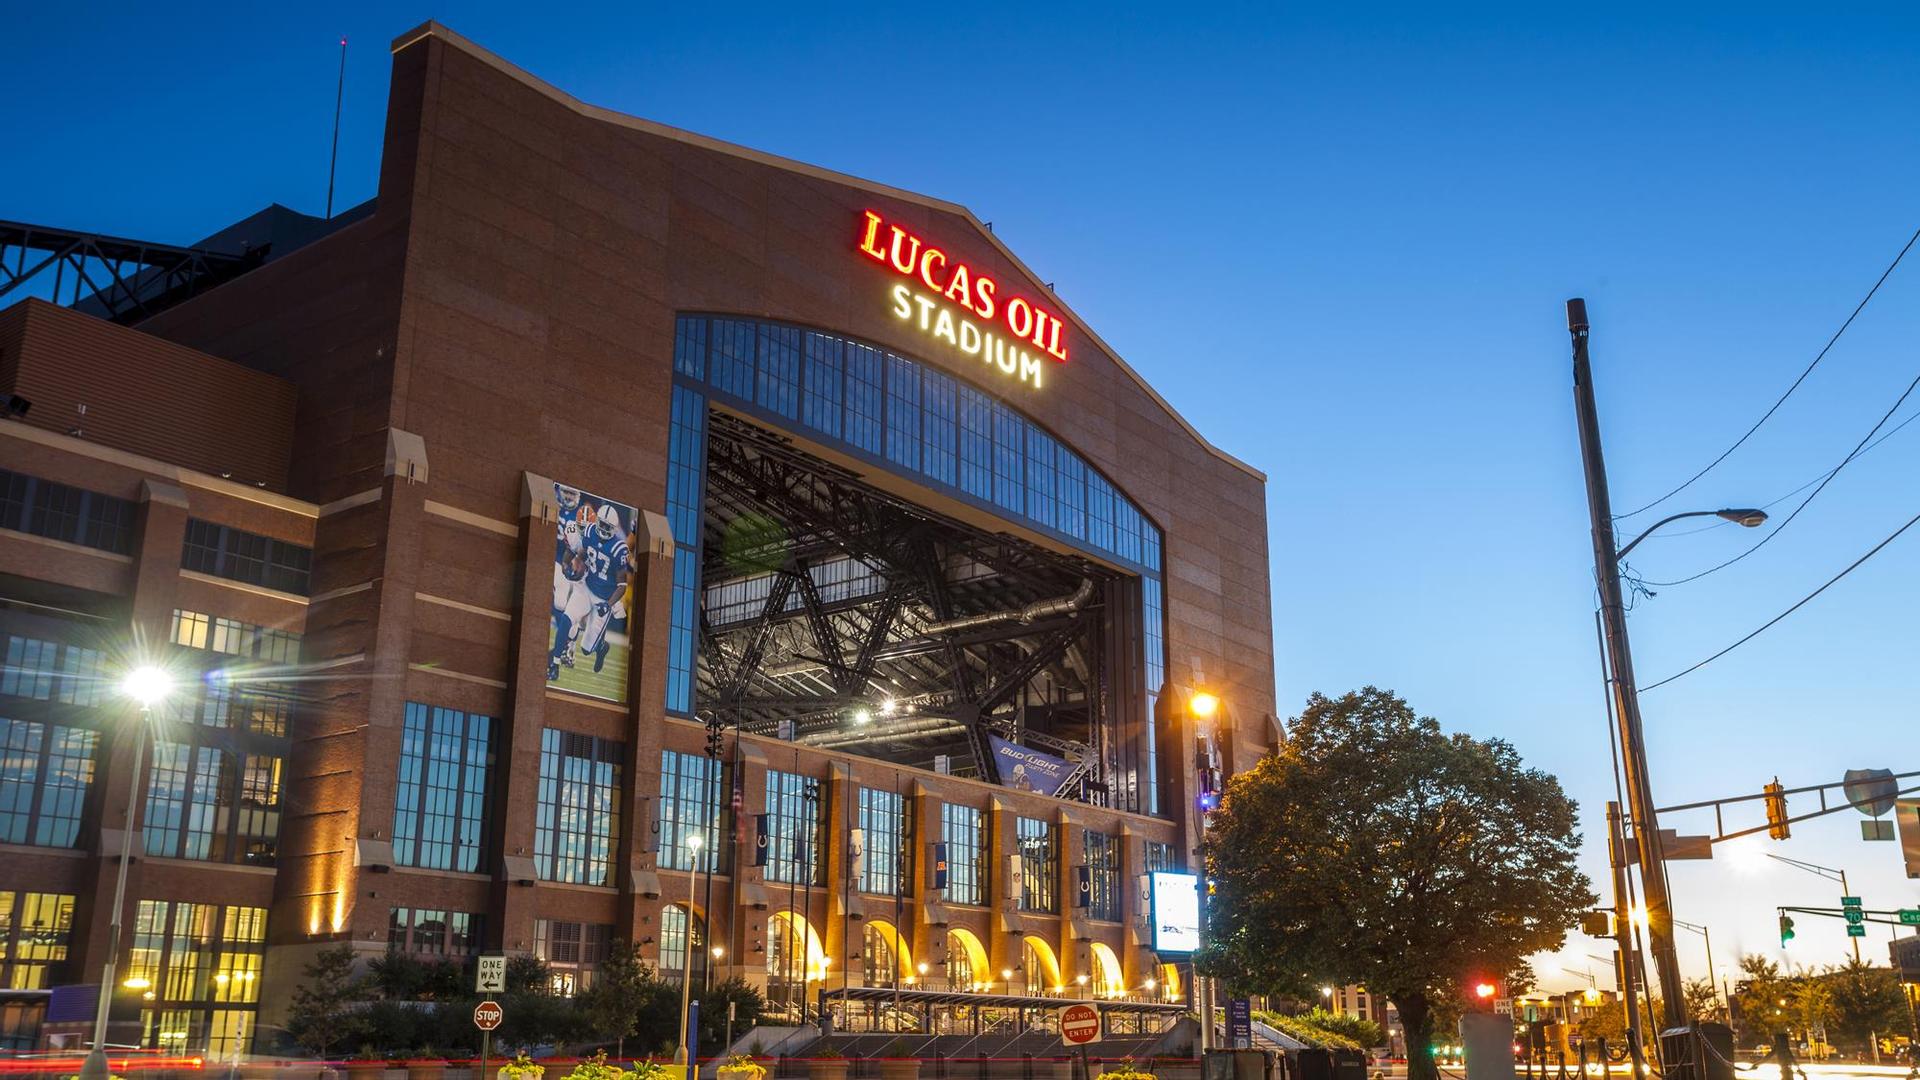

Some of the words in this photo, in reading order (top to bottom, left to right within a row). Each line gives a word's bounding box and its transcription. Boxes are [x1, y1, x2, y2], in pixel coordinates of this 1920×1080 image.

[861, 210, 996, 320] LUCAS
[1007, 297, 1067, 361] OIL
[892, 284, 1042, 388] STADIUM
[586, 545, 610, 580] 87
[1000, 746, 1025, 760] BUD
[1028, 755, 1060, 771] LIGHT
[1025, 762, 1043, 773] PARTY
[1043, 769, 1060, 778] ZONE
[1846, 912, 1861, 922] 70
[482, 960, 502, 969] ONE
[481, 971, 502, 980] WAY
[477, 1010, 500, 1021] STOP
[1079, 1011, 1092, 1019] NOT
[1069, 1028, 1093, 1038] ENTER
